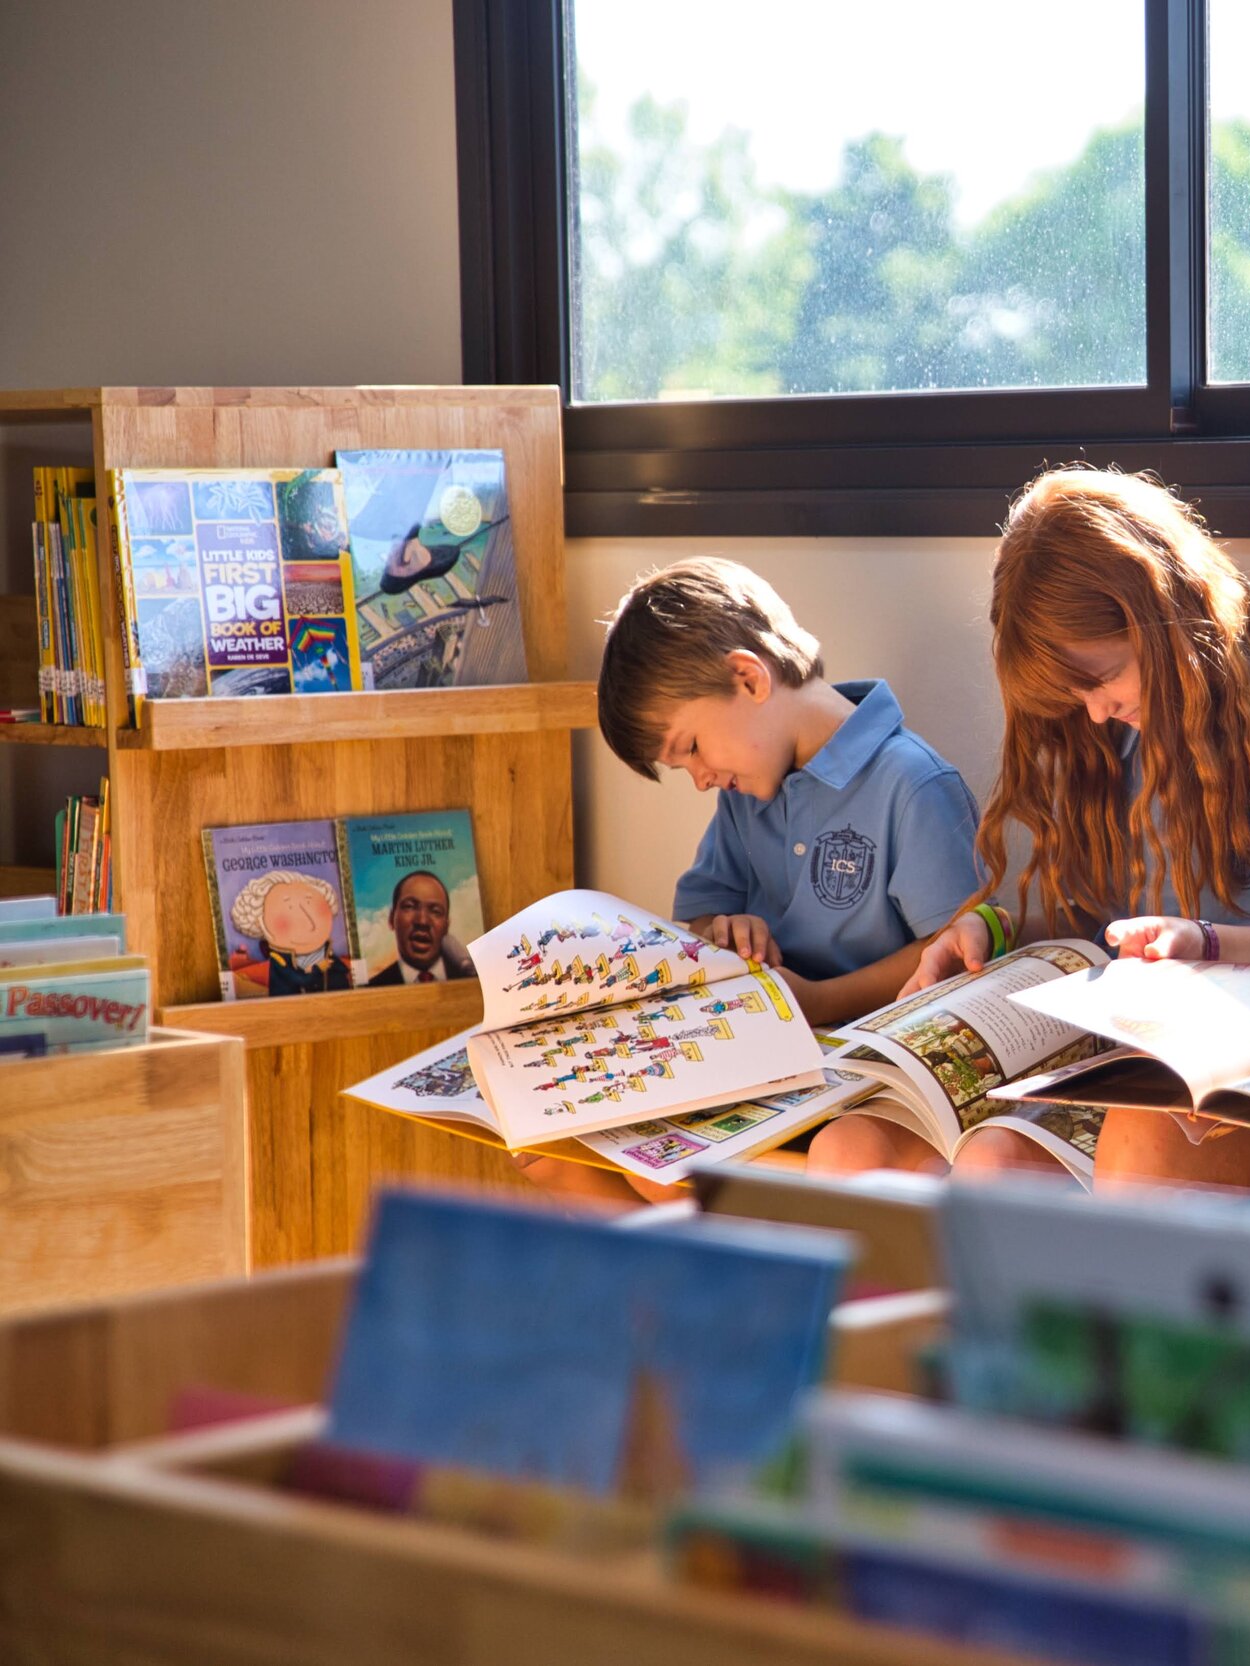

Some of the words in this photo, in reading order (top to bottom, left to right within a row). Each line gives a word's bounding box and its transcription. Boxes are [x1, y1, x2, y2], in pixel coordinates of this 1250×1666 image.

[202, 550, 243, 562] LITTLE
[246, 549, 275, 561] KIDS
[203, 562, 277, 585] FIRST
[205, 584, 281, 622] BIG
[210, 621, 257, 638] BOOK
[260, 621, 282, 636] OF
[210, 636, 285, 654] WEATHER
[371, 840, 413, 856] MARTIN
[415, 838, 455, 853] LUTHER
[394, 854, 419, 868] KING
[421, 853, 436, 867] JR.
[831, 859, 855, 874] ICS
[6, 985, 146, 1032] Passover!
